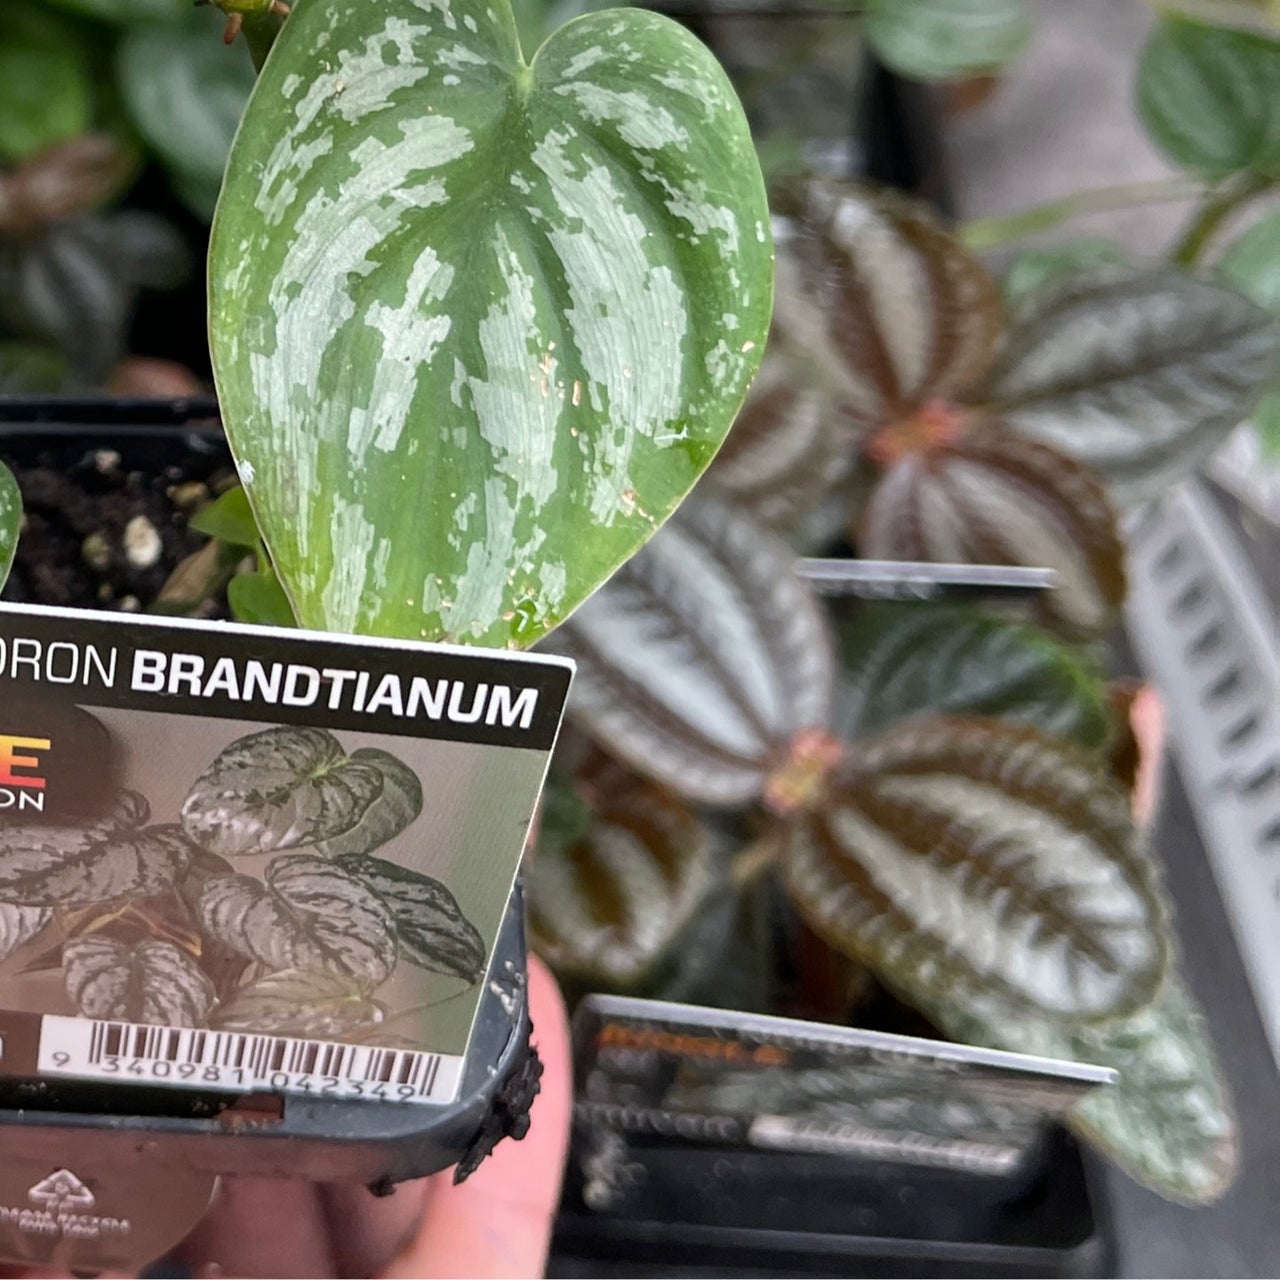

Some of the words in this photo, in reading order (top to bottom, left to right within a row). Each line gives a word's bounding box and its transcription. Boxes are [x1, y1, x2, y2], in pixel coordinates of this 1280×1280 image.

[131, 649, 539, 728] BRANDTIANUM
[52, 1051, 70, 1067] 9
[101, 1053, 244, 1084] 340981
